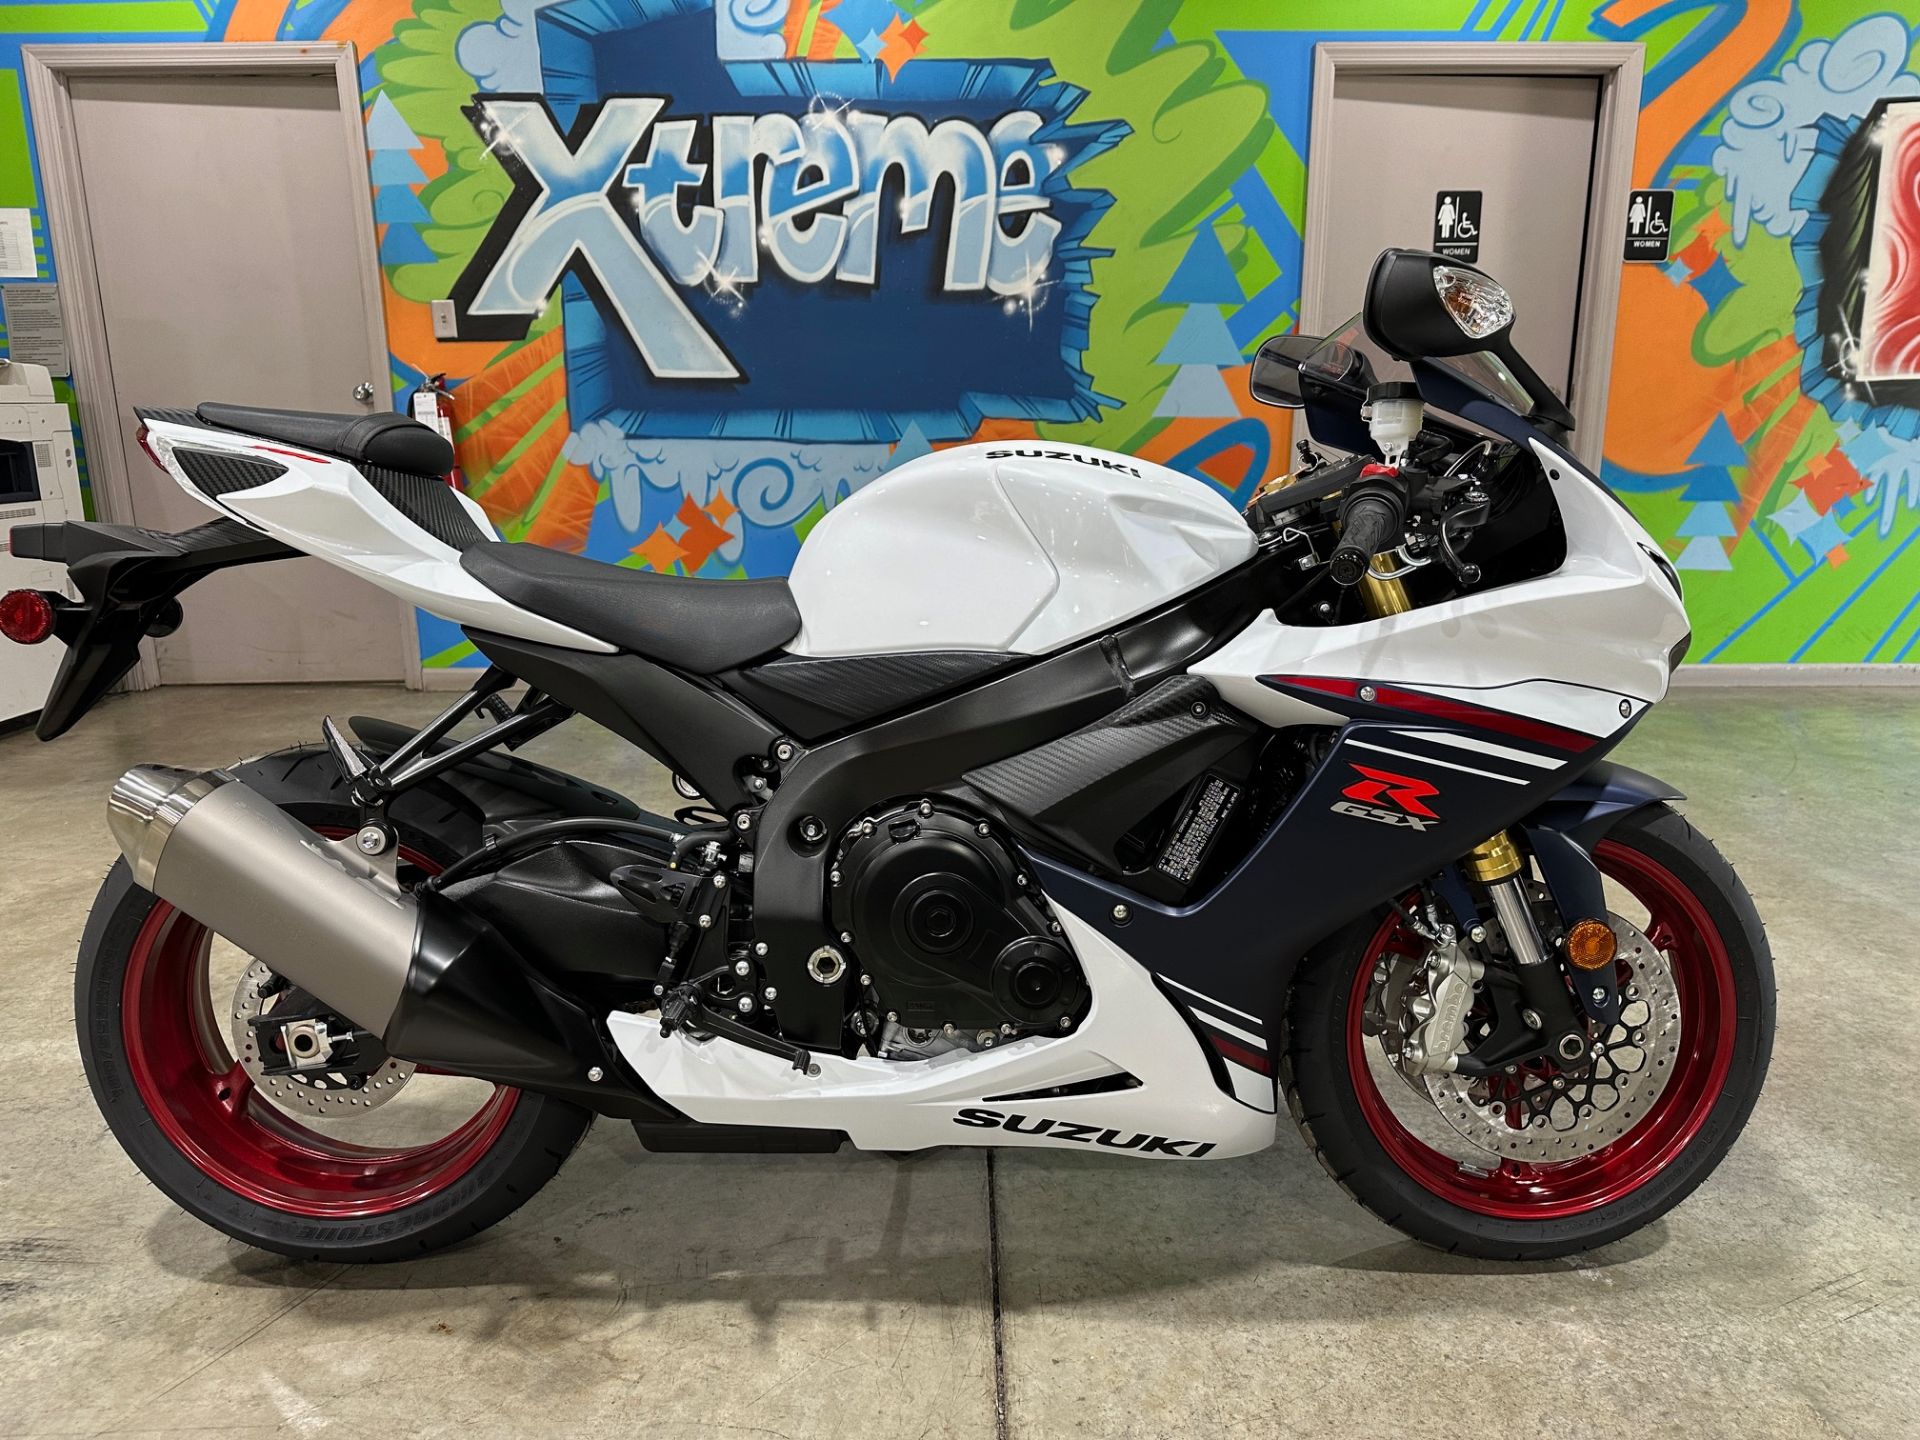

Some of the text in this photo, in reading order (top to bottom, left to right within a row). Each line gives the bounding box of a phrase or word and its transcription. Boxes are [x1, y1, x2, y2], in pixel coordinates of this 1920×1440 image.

[466, 97, 1062, 380] Xtreme
[1442, 247, 1471, 256] WOMEN
[1633, 240, 1661, 249] WOMEN
[985, 450, 1142, 479] SUZUKI
[1341, 762, 1441, 819] R
[1329, 801, 1440, 832] GSX
[953, 1108, 1217, 1158] SUZUKI
